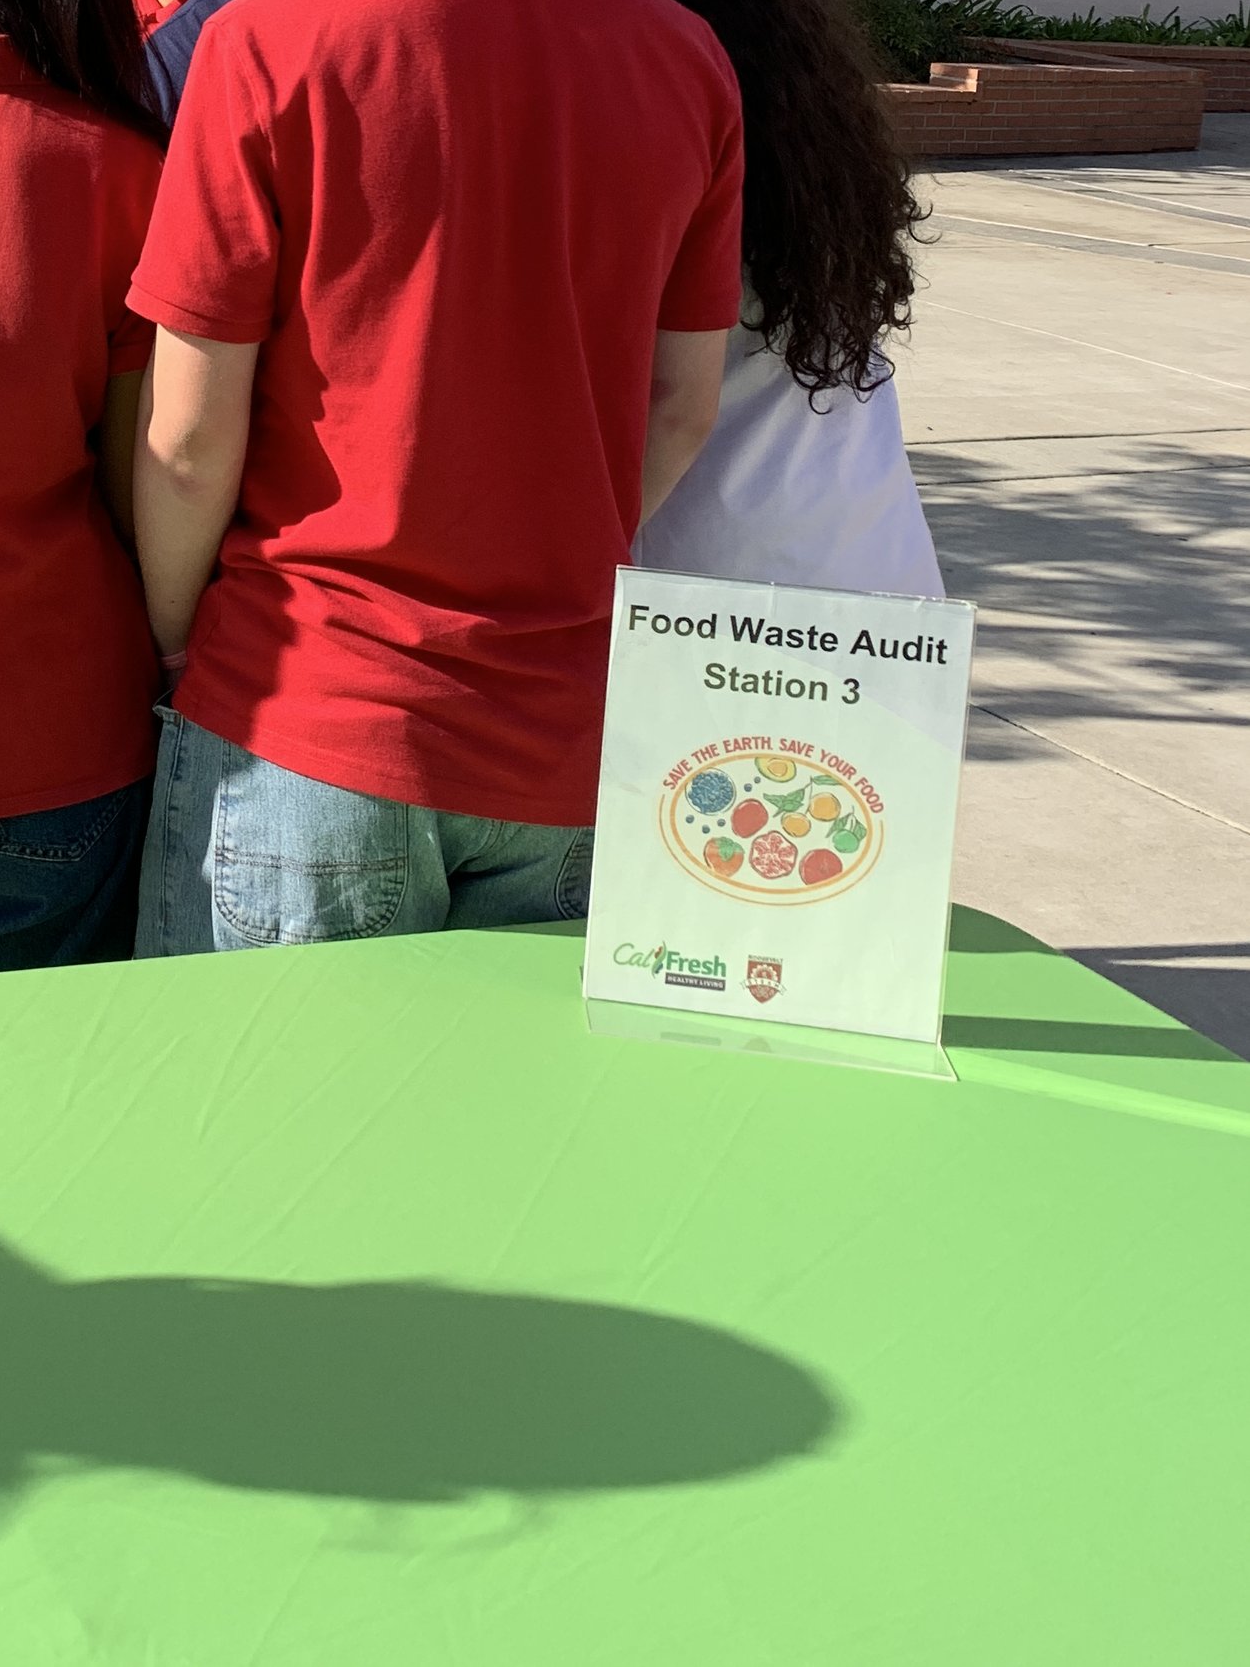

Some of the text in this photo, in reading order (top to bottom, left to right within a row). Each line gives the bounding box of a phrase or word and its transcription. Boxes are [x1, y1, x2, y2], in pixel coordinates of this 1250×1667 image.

[629, 604, 948, 664] Food Waste Audit
[704, 663, 861, 704] Station 3
[663, 759, 693, 790] SAVE
[691, 743, 720, 764] THE
[779, 738, 814, 758] SAVE
[820, 749, 857, 779] YOUR
[854, 777, 884, 814] FOOD
